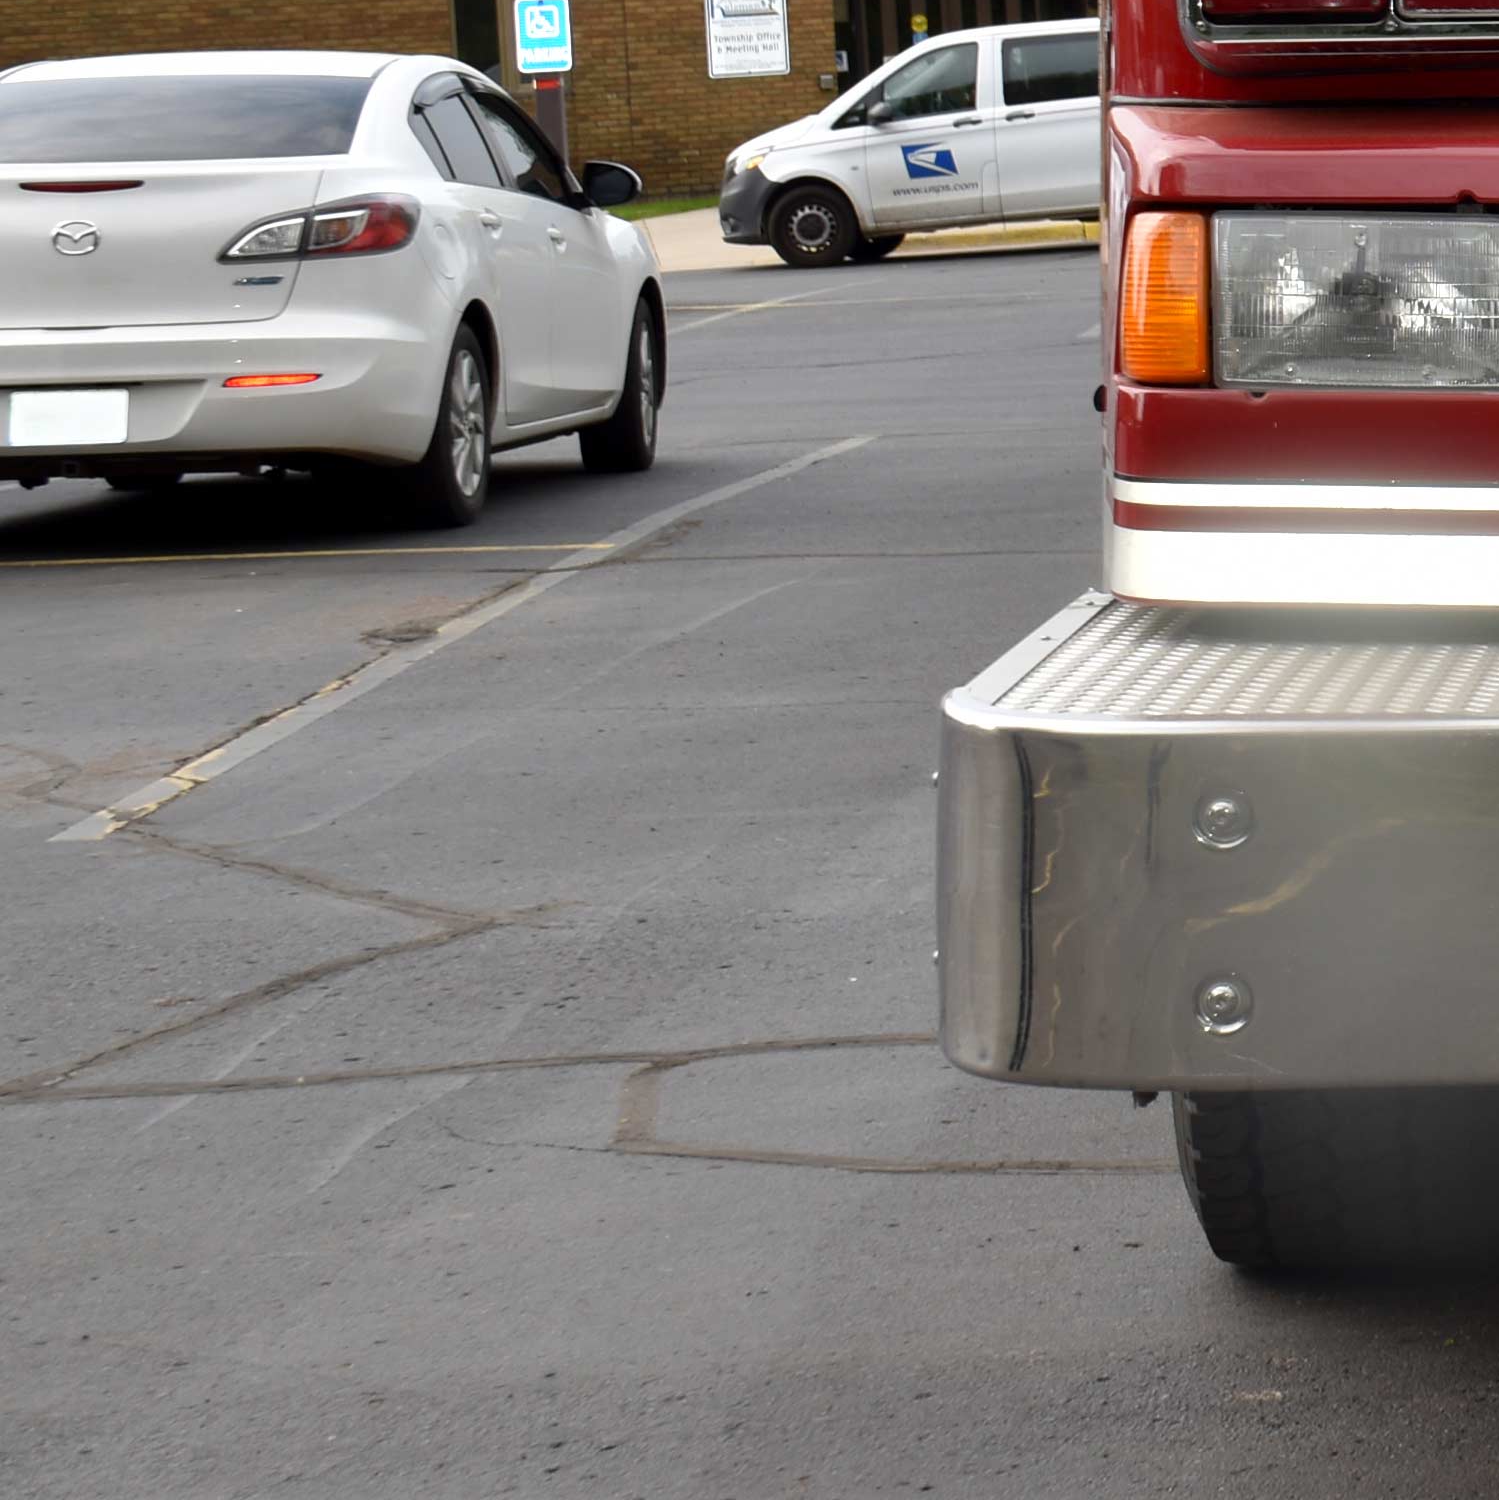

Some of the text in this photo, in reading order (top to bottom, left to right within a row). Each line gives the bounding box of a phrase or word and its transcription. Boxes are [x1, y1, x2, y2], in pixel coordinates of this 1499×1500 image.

[714, 32, 781, 44] Township Office
[726, 44, 759, 53] Meeting
[763, 43, 779, 51] Hall
[892, 181, 979, 197] www.usps.com
